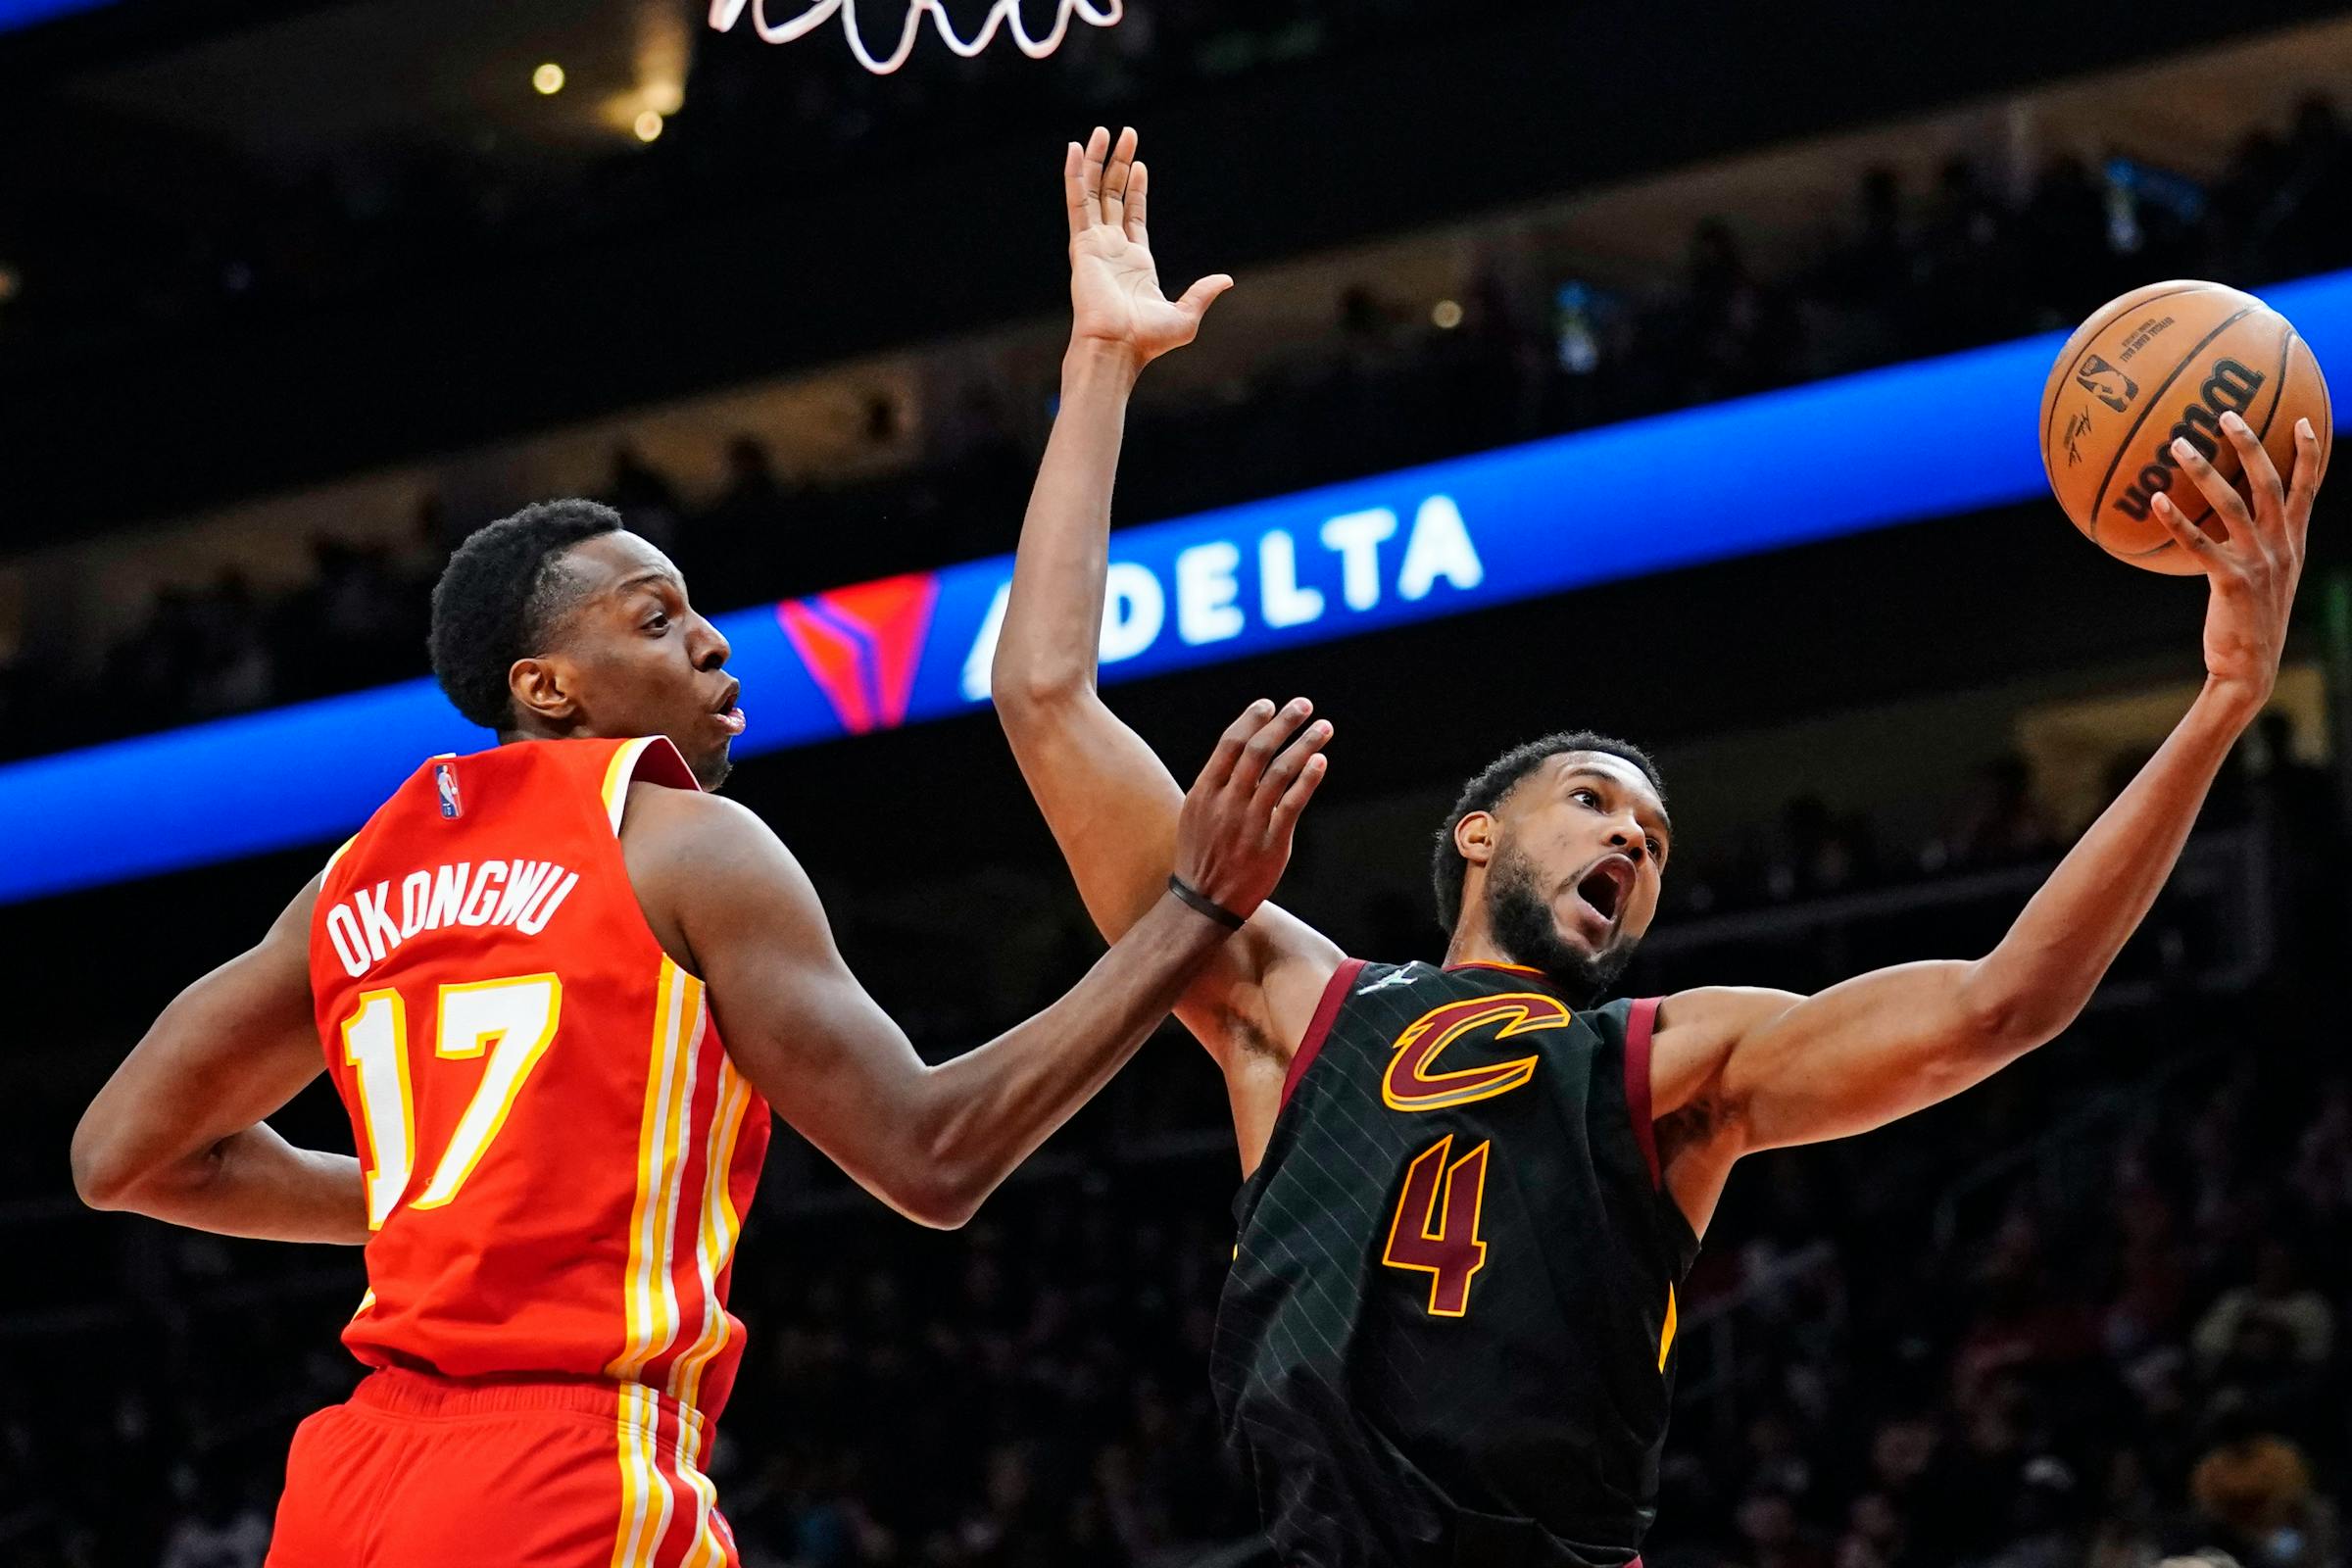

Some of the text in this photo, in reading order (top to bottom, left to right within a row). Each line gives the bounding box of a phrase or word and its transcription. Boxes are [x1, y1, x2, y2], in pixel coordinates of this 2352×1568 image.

[326, 858, 579, 978] OKONGWU
[340, 971, 564, 1232] 17
[1382, 992, 1572, 1112] C
[1382, 1133, 1491, 1318] 4
